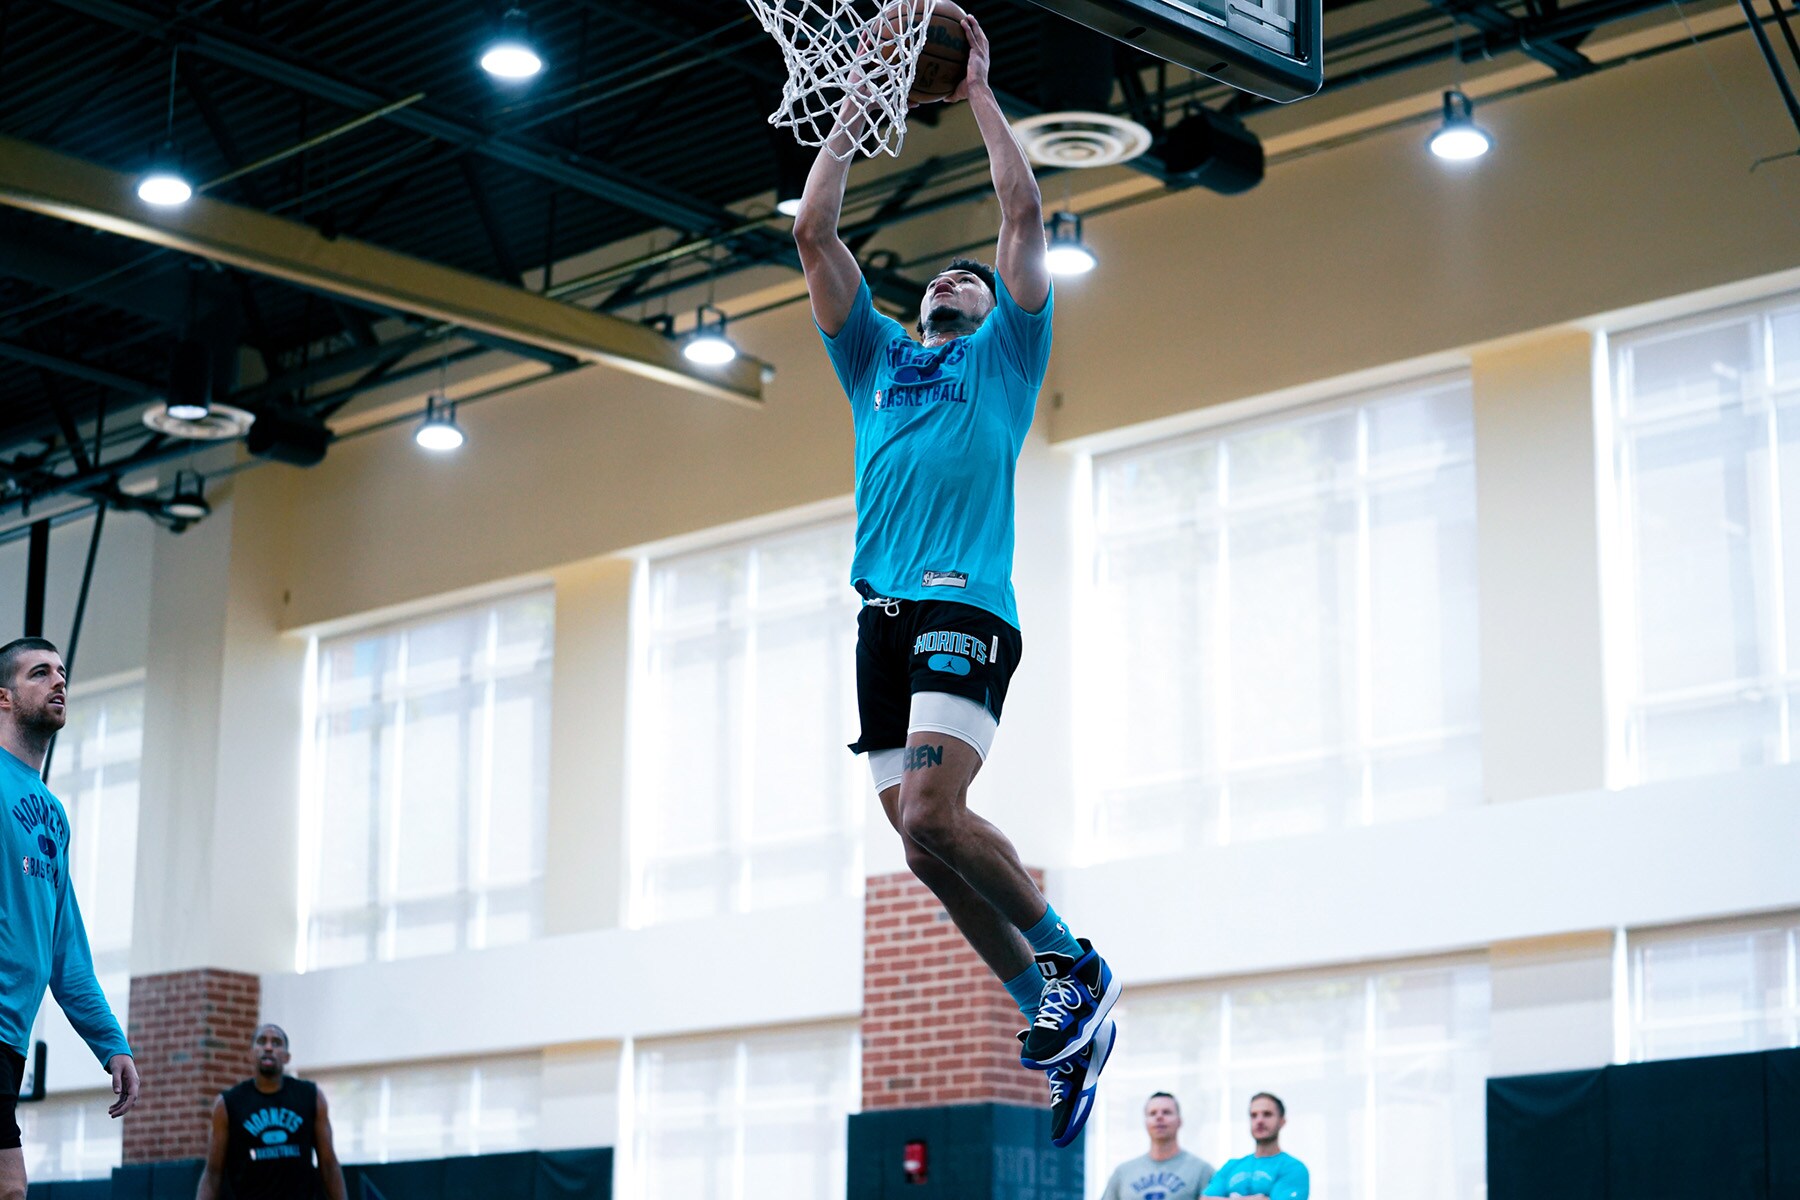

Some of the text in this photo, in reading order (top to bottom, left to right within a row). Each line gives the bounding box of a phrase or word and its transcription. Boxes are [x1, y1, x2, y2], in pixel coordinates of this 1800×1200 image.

[881, 383, 966, 408] BASKETBALL
[914, 631, 987, 665] HORNETS
[243, 1107, 304, 1137] HORNETS
